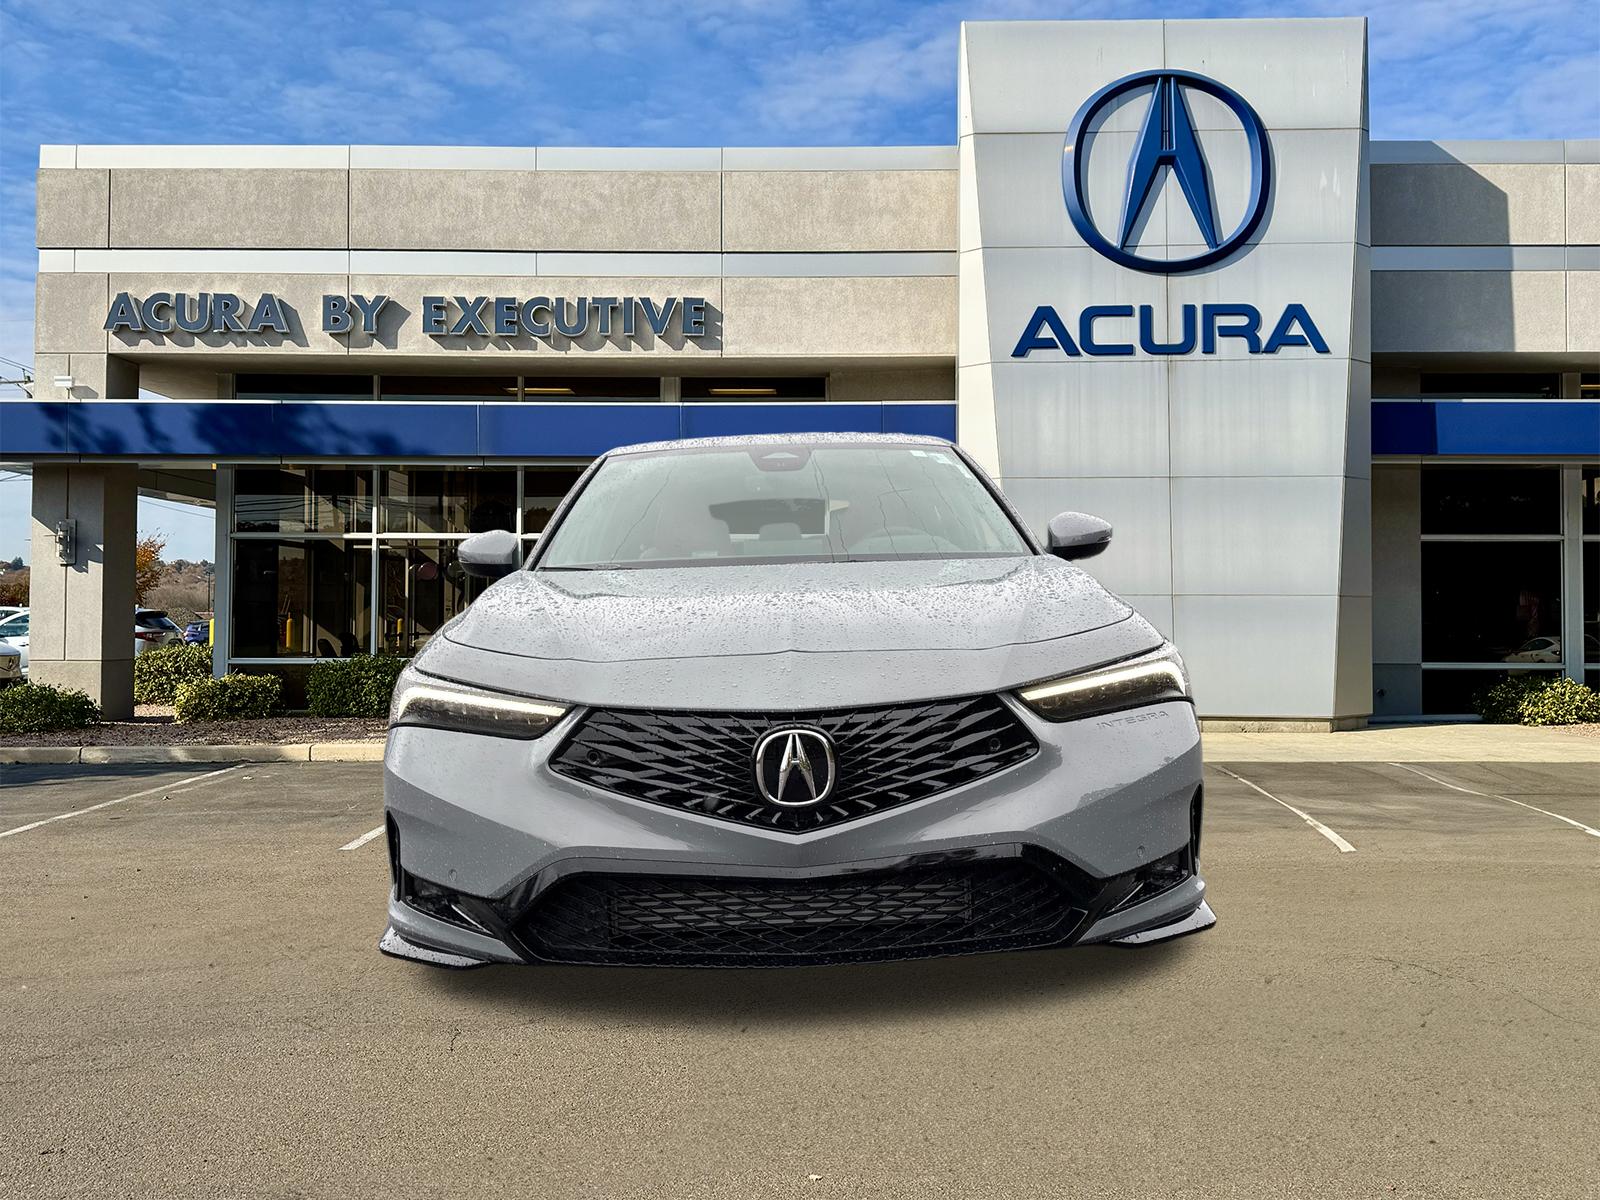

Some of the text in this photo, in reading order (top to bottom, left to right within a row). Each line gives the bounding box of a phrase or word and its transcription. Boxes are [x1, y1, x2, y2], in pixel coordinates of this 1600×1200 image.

[104, 292, 706, 337] ACURA BY EXECUTIVE
[1011, 303, 1332, 357] ACURA
[1096, 710, 1169, 728] INTEGRA
